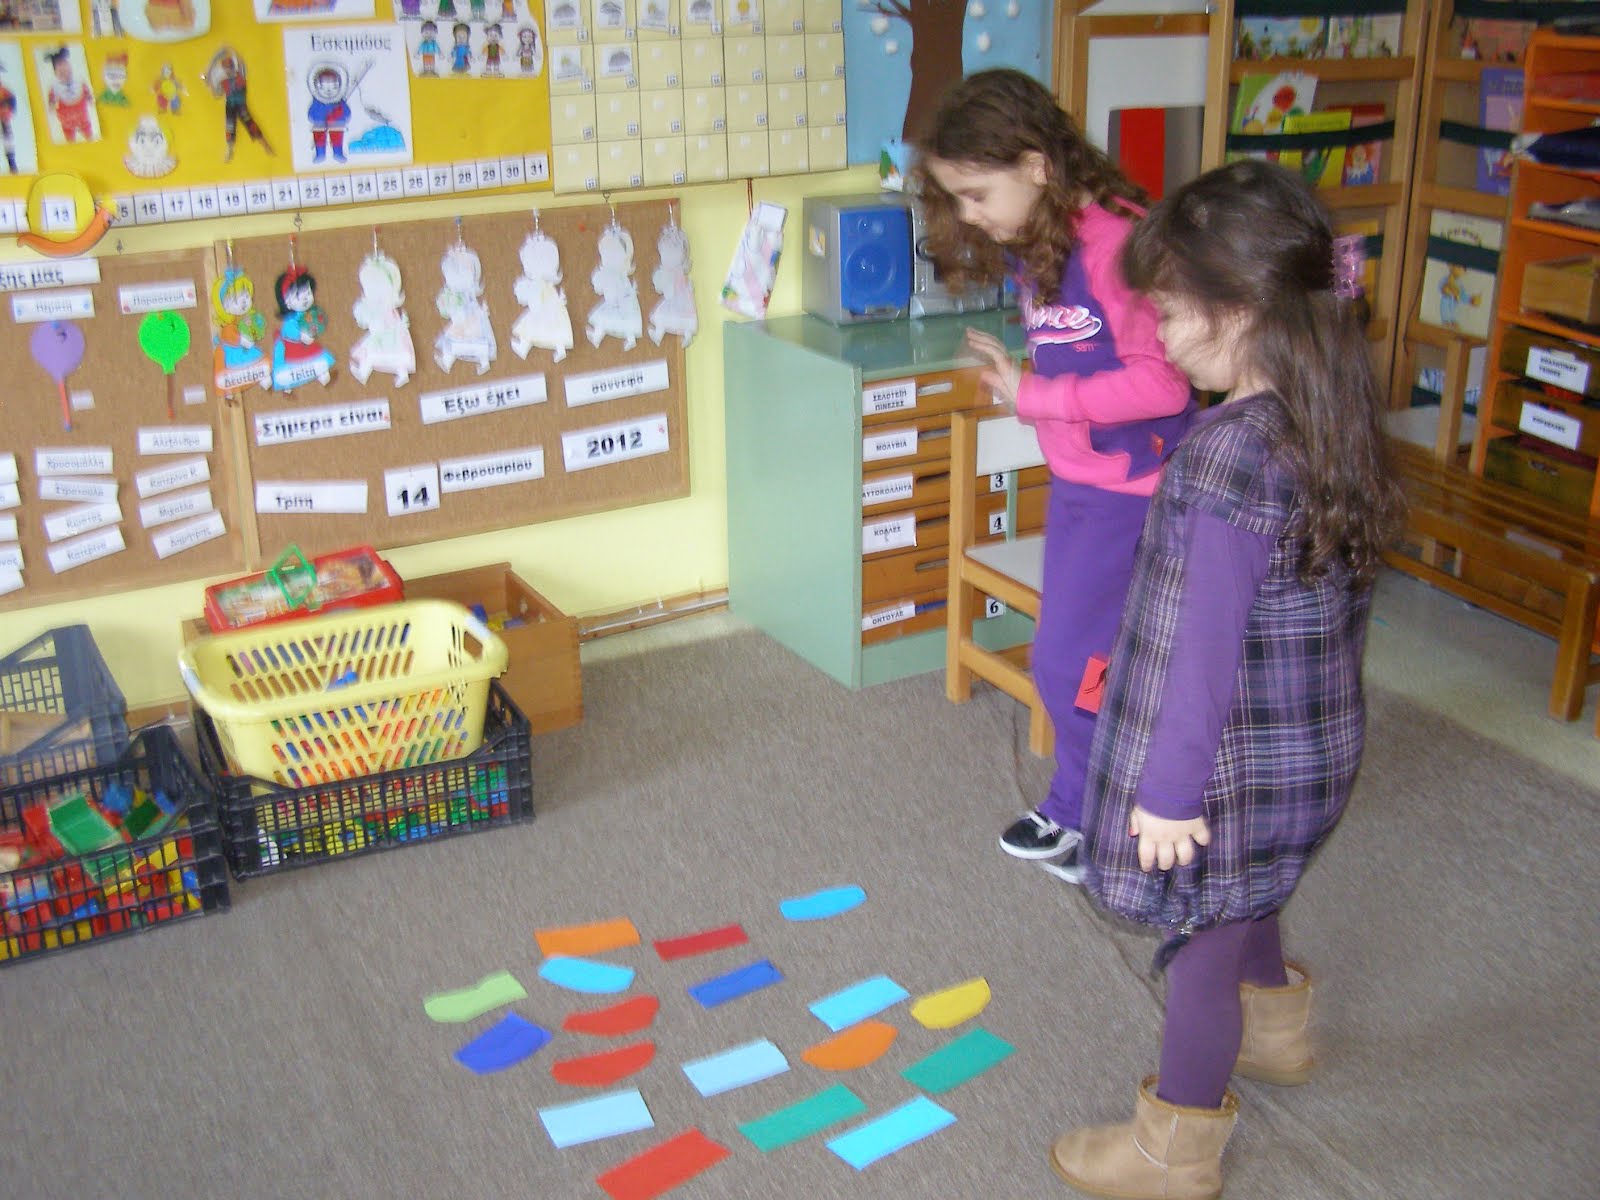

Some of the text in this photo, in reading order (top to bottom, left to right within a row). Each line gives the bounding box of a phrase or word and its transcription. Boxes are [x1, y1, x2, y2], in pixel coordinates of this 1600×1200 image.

[54, 206, 70, 222] 13
[141, 203, 158, 215] 16
[170, 200, 184, 213] 17
[199, 197, 213, 209] 18
[226, 194, 240, 207] 19
[252, 192, 267, 205] 20
[279, 188, 293, 201] 21
[305, 187, 320, 199] 22
[331, 184, 346, 197] 23
[357, 182, 371, 195] 24
[383, 180, 398, 193] 25
[408, 176, 423, 189] 26
[433, 174, 447, 187] 27
[458, 172, 472, 185] 28
[482, 168, 496, 181] 29
[506, 166, 519, 178] 30
[530, 163, 543, 175] 31
[32, 268, 65, 287] μας
[224, 369, 265, 388] Δευτέρα
[487, 387, 520, 406] έχει
[875, 400, 905, 411] ΠΙΝΕΖΕΣ
[262, 407, 383, 438] Σήμερα είναι
[587, 430, 643, 458] 2012
[397, 459, 532, 510] 14 Φεβρουαρίου
[994, 474, 1004, 488] 3
[993, 516, 1003, 531] 4
[990, 600, 999, 614] 6
